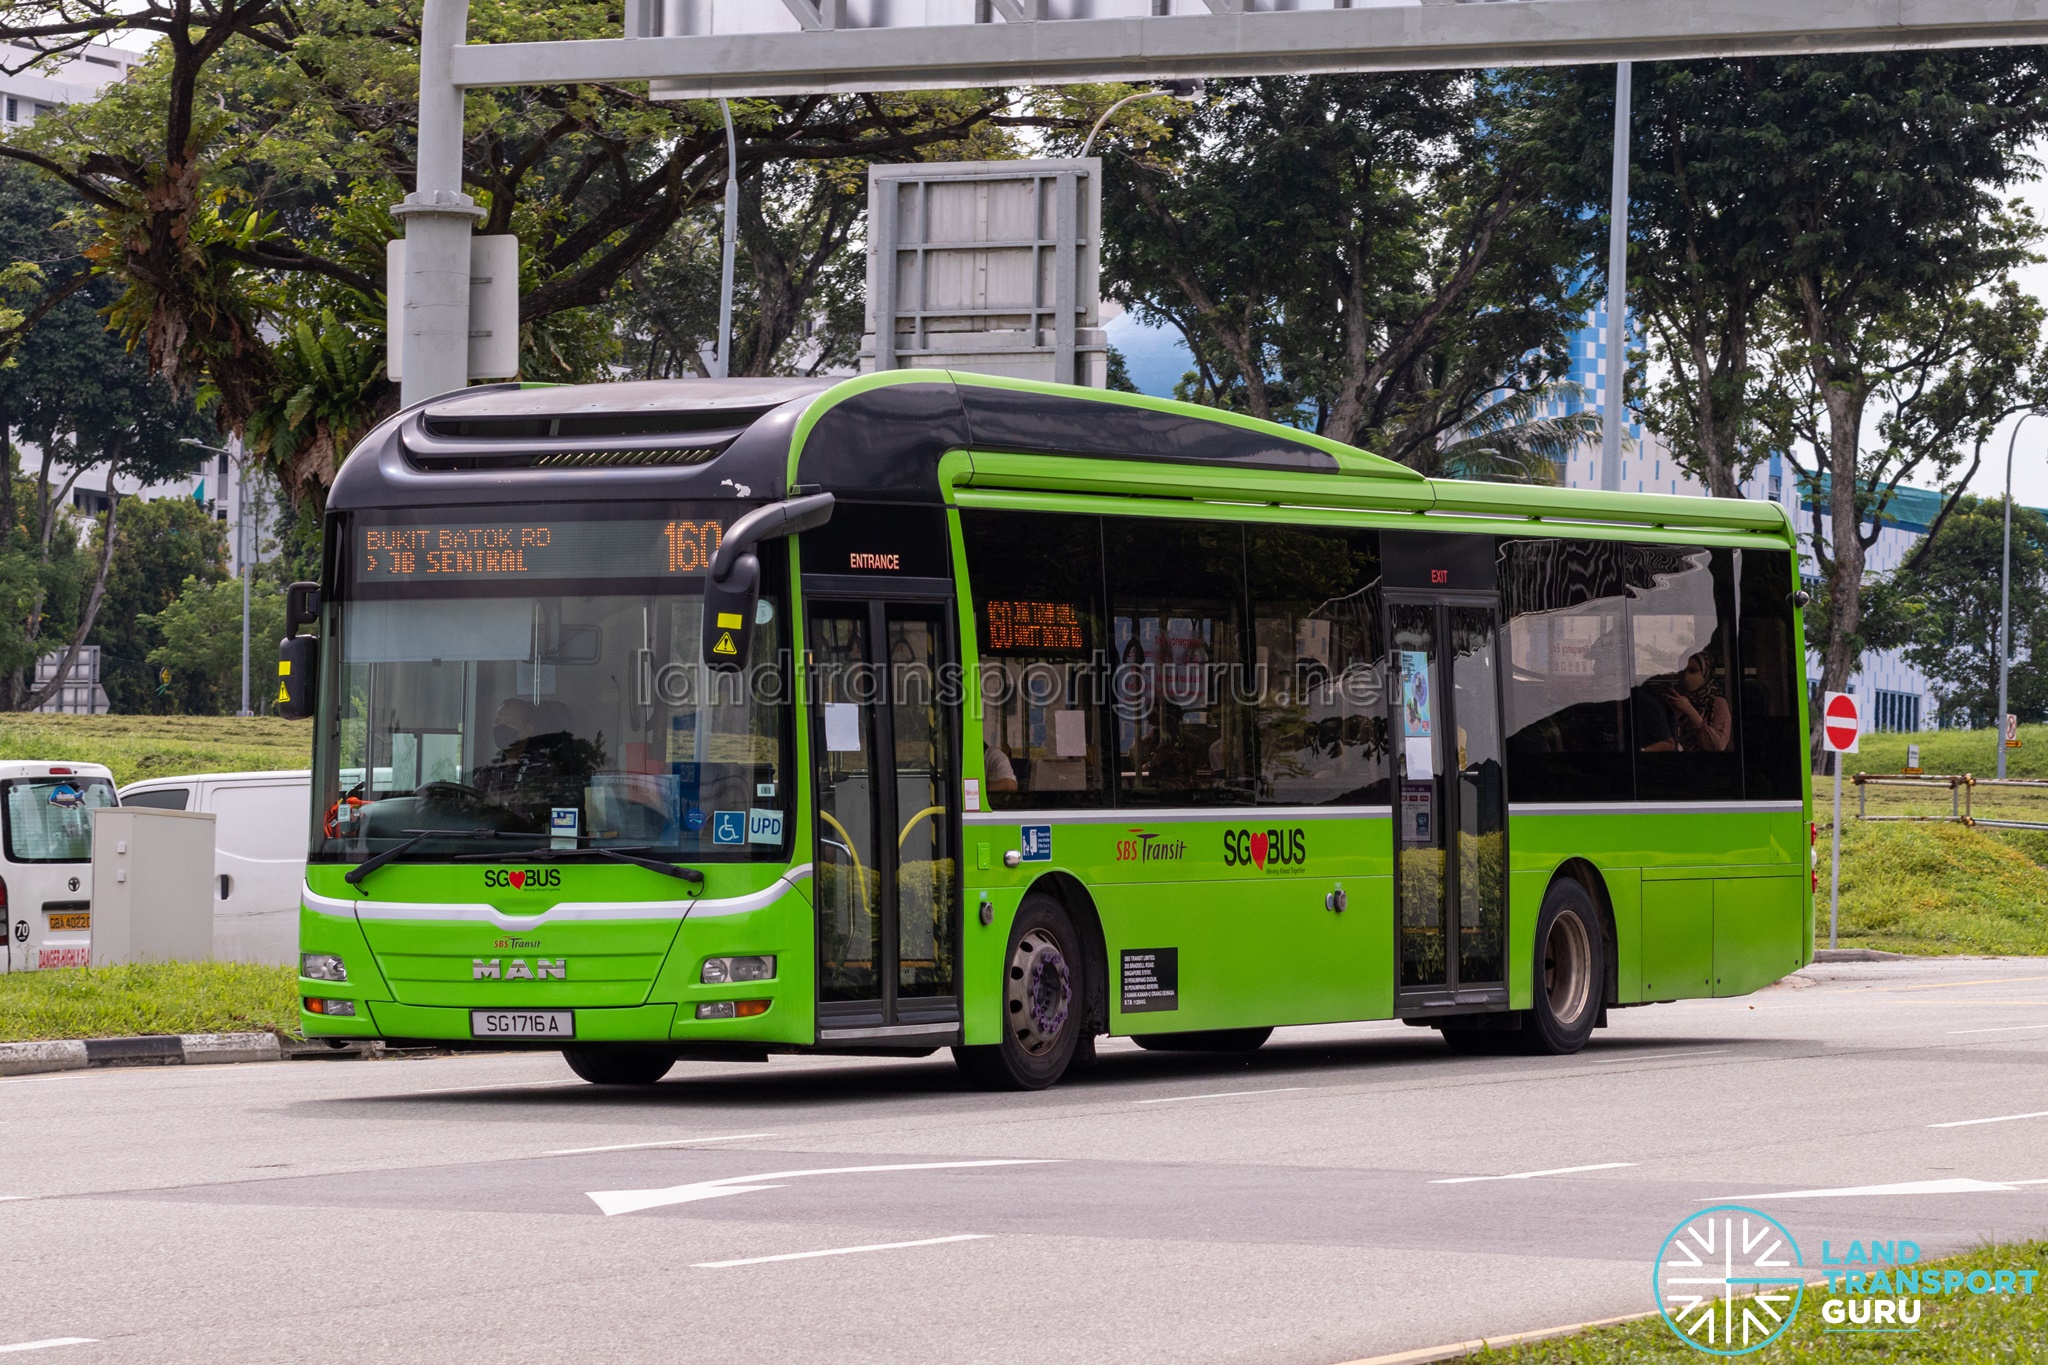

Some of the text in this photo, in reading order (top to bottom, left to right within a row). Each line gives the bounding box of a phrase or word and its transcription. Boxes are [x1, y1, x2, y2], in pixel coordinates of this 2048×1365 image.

[367, 527, 551, 550] BUKIT BATOK RD
[664, 521, 722, 572] 160
[389, 551, 415, 573] JB
[426, 549, 528, 573] SENTRAL
[850, 552, 900, 570] ENTRANCE
[1431, 569, 1448, 583] EXIT
[751, 817, 781, 836] UPD
[1115, 833, 1188, 865] SBS Transit
[1266, 828, 1306, 865] BUS
[524, 868, 562, 887] BUS
[16, 923, 29, 937] 70
[50, 917, 65, 930] GBA
[493, 937, 541, 949] SBS Transit
[472, 958, 567, 980] MAN
[486, 1015, 560, 1033] SG1716A
